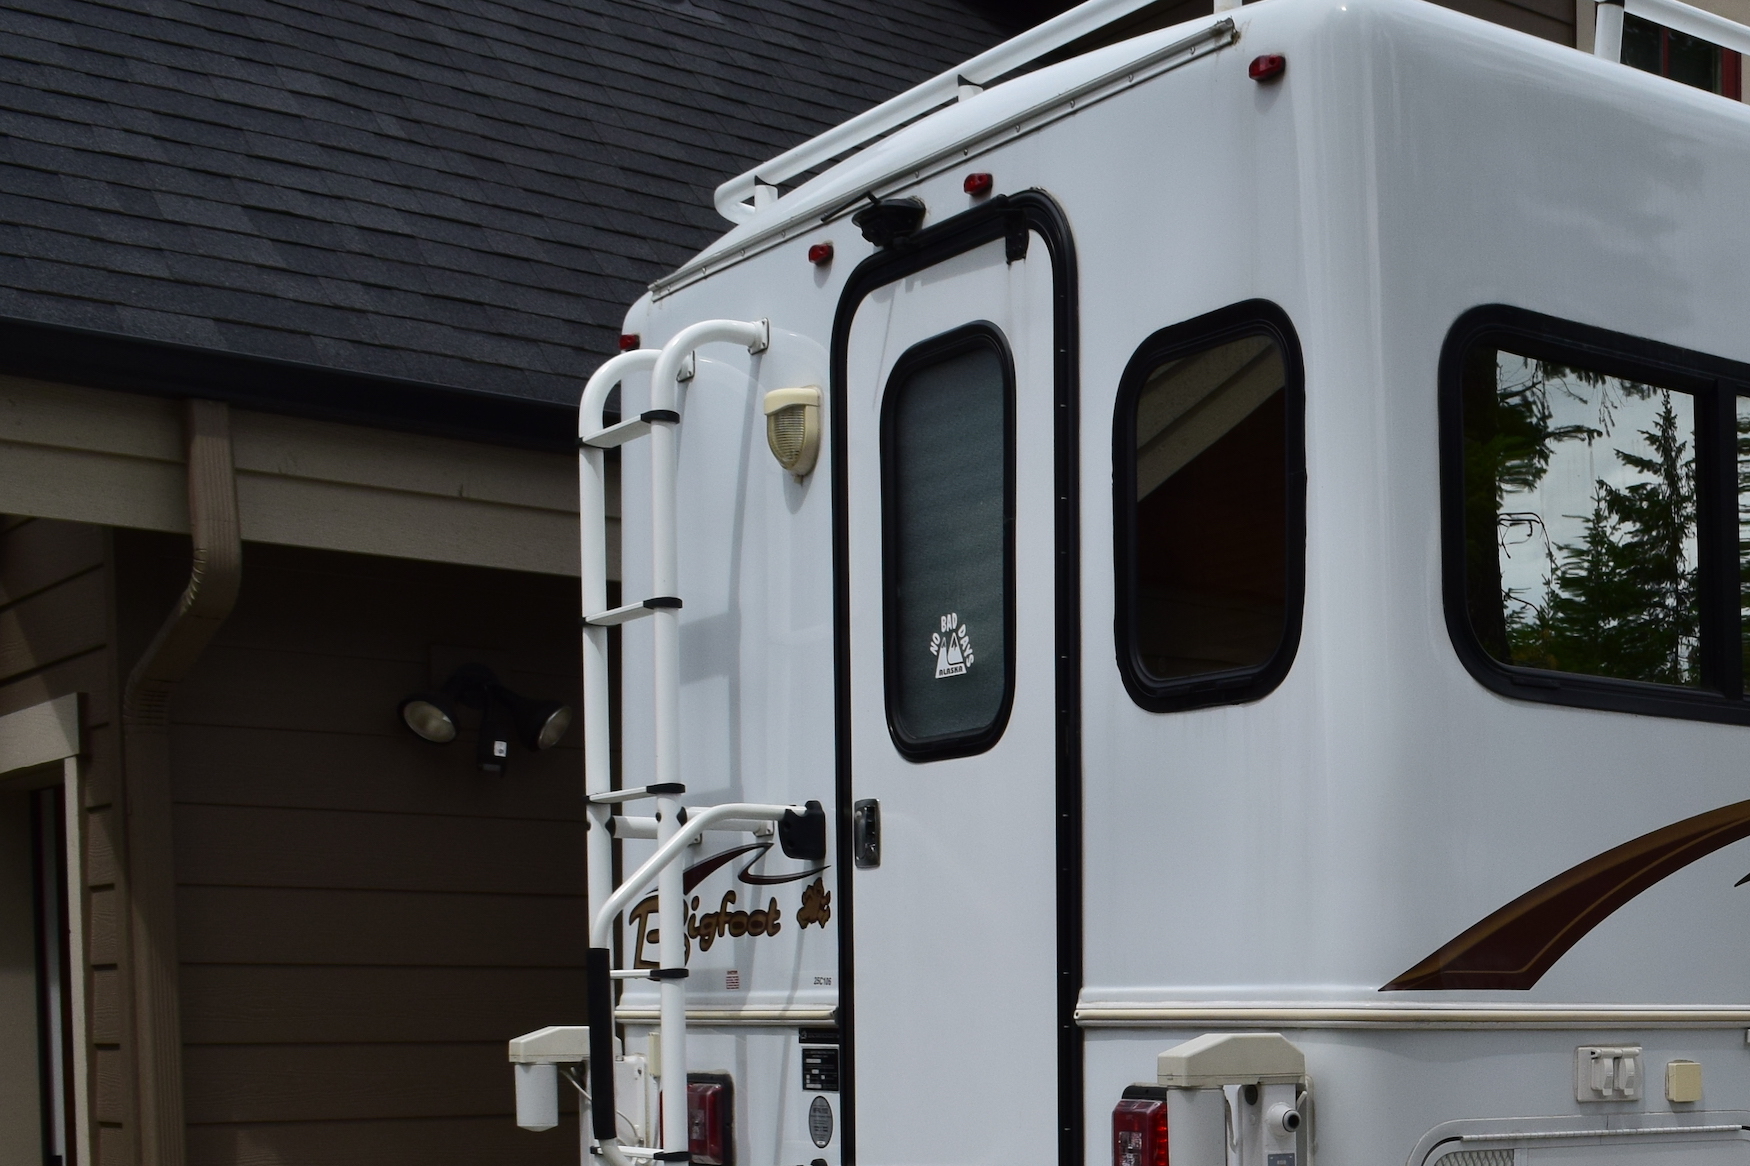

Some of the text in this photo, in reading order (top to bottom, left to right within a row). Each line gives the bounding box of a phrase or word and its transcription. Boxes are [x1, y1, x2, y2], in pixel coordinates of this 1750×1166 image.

[929, 612, 974, 668] NO BAD DAYS
[939, 666, 963, 676] ALASKA
